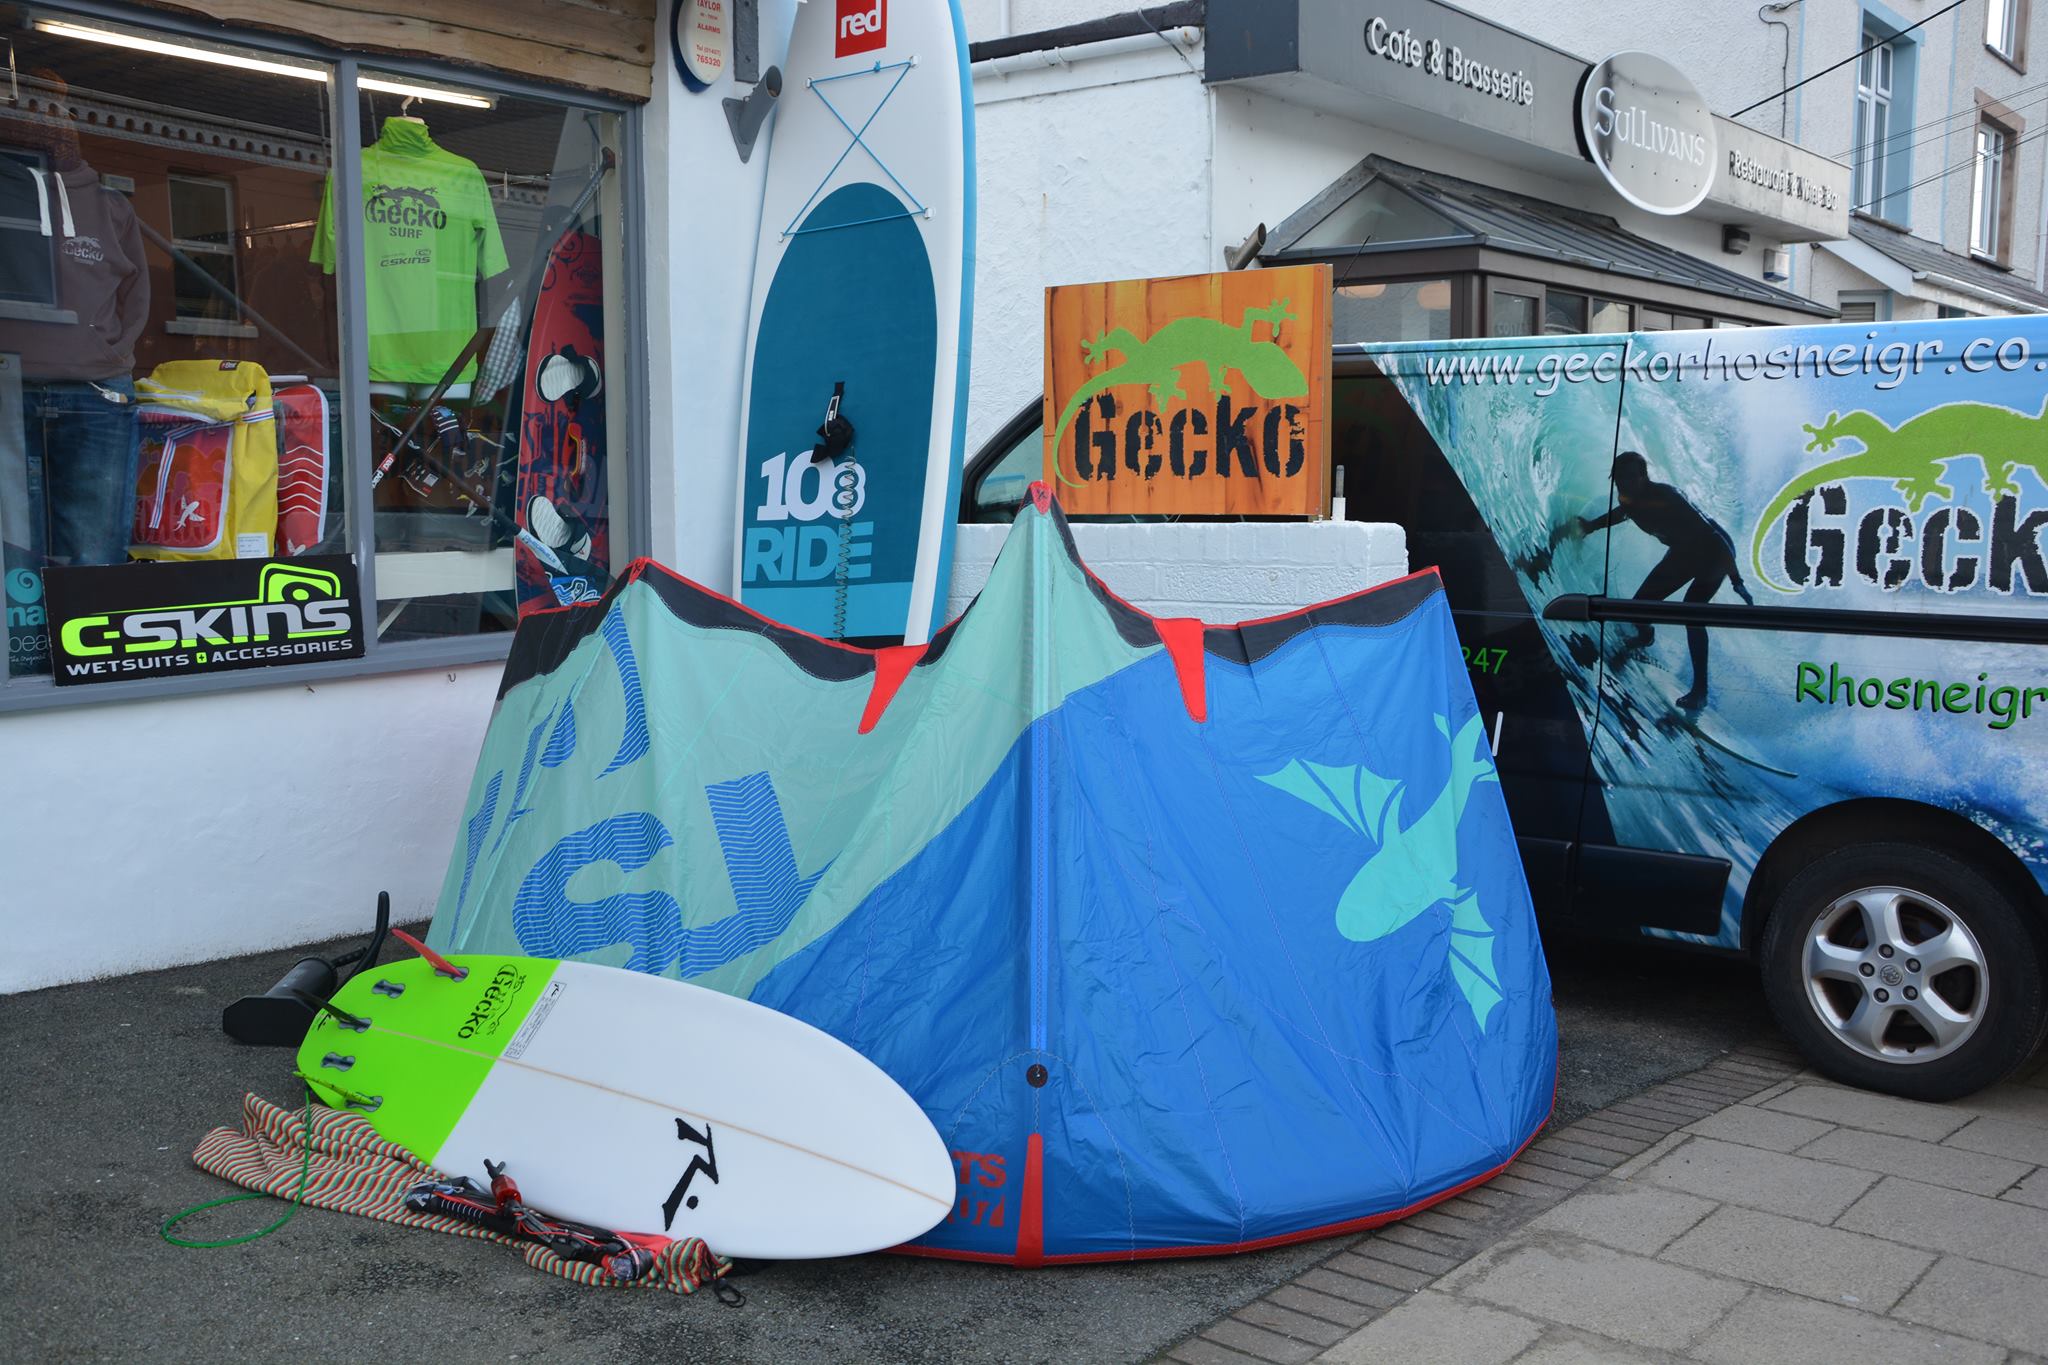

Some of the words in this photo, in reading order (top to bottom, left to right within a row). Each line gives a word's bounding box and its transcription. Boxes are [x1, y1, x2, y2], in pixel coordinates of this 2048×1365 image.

[697, 23, 721, 34] ALARMS
[841, 0, 882, 39] red
[696, 54, 721, 67] 765320
[1370, 16, 1423, 68] Cafe
[1430, 38, 1444, 76] &
[1451, 46, 1534, 106] Brasserie
[1734, 149, 1790, 194] Restaurant
[369, 197, 447, 230] Gecko
[389, 226, 423, 239] SURF
[1074, 393, 1305, 482] Gecko
[743, 521, 874, 582] RIDE
[66, 653, 190, 677] WETSUITS
[211, 639, 353, 663] ACCESSORIES
